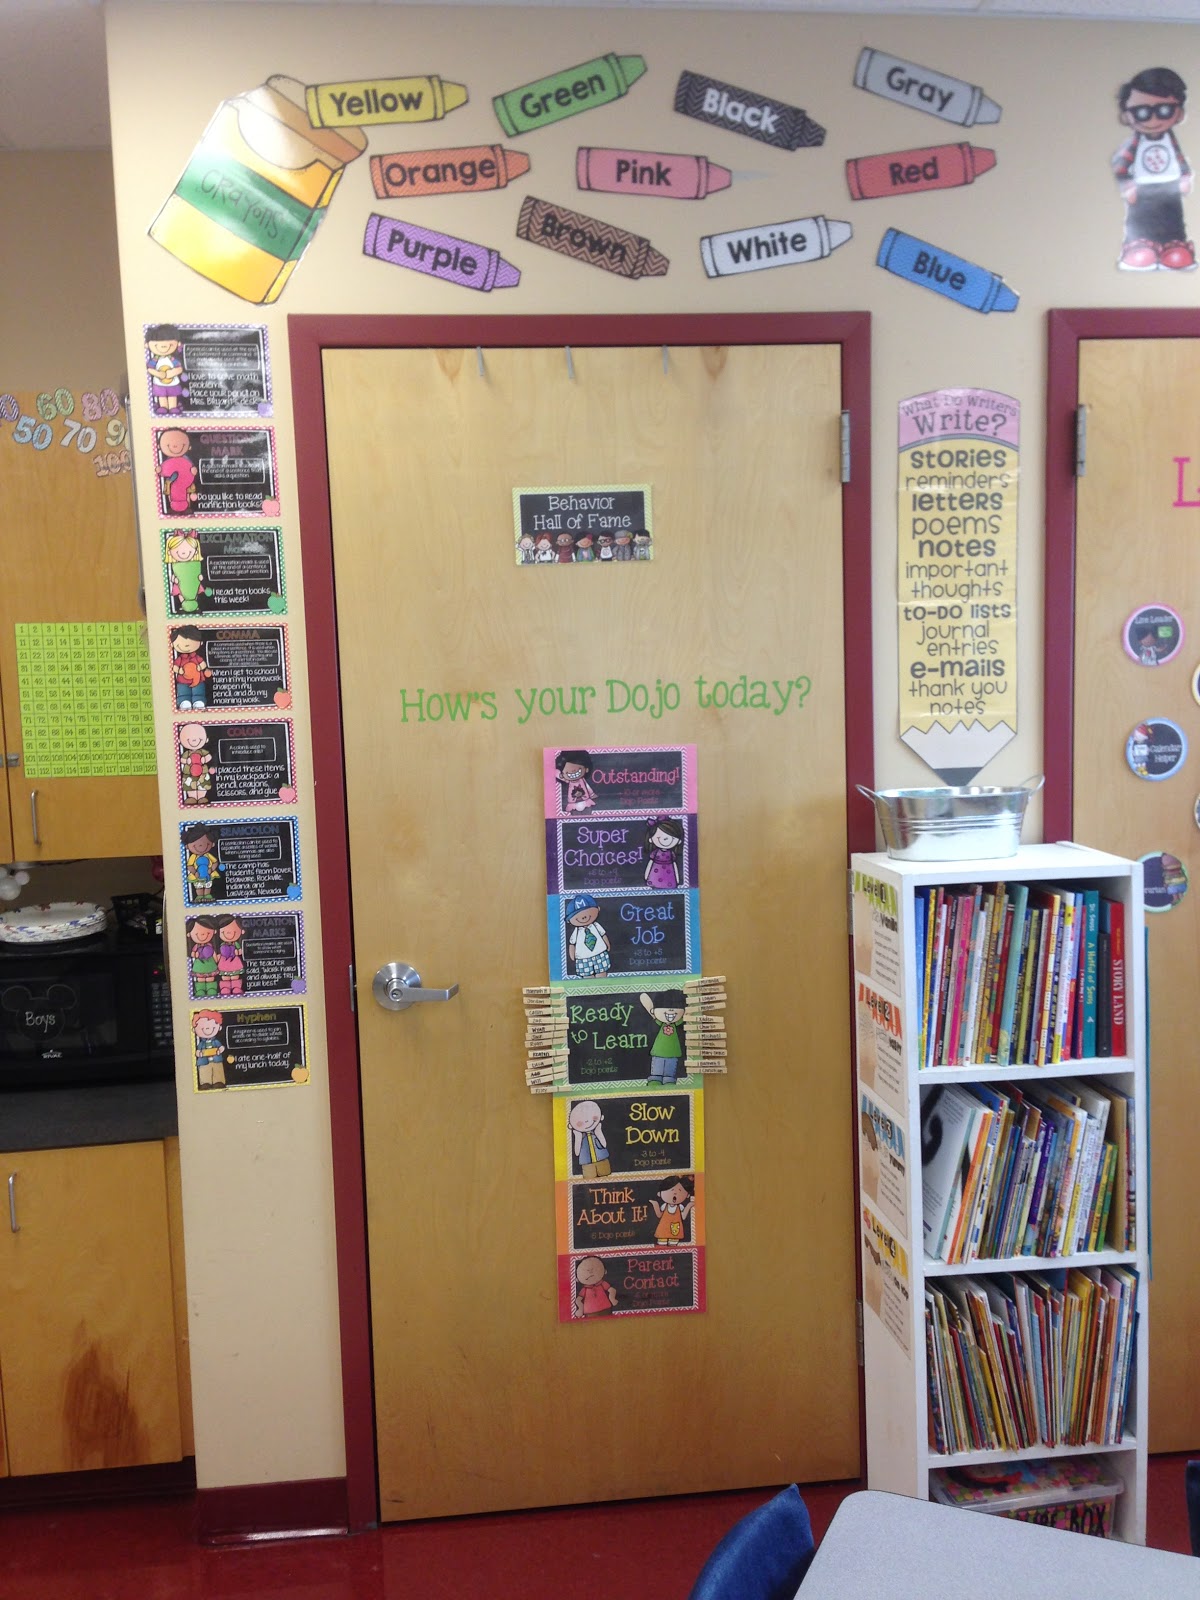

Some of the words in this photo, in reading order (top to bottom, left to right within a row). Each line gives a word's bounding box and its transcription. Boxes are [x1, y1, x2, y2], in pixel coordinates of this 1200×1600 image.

[518, 72, 607, 119] Green
[885, 66, 953, 113] Gray
[328, 88, 424, 118] Yellow
[702, 87, 780, 135] Black
[385, 154, 497, 187] Orange
[615, 159, 672, 186] Pink
[889, 156, 940, 186] Red
[539, 212, 630, 263] Brown
[727, 231, 808, 264] White
[386, 230, 479, 277] Purple
[912, 250, 967, 291] Blue
[36, 387, 75, 421] 60
[81, 388, 120, 421] 80
[902, 395, 940, 417] What
[967, 395, 1018, 417] Writers
[912, 409, 1007, 436] Write?
[12, 415, 53, 452] 50
[60, 418, 97, 453] 70
[905, 471, 1012, 490] reminders
[208, 493, 220, 502] you
[548, 495, 615, 511] Behavior
[533, 514, 562, 531] Hall
[566, 513, 584, 529] of
[587, 513, 632, 529] Fame
[912, 514, 1003, 540] poems
[918, 538, 997, 558] notes
[906, 559, 1008, 581] important
[911, 579, 1004, 603] thoughts
[971, 603, 1011, 619] lists
[60, 638, 67, 646] 14
[216, 631, 260, 640] COMMA
[916, 620, 990, 646] journal
[926, 638, 1000, 657] entries
[910, 658, 1005, 679] e-mails
[61, 677, 70, 685] 44
[908, 678, 966, 697] thank
[971, 680, 1008, 700] you
[102, 689, 111, 697] 57
[399, 688, 499, 723] How's
[514, 686, 597, 725] your
[605, 678, 681, 720] Dojo
[694, 674, 812, 716] today?
[929, 698, 987, 716] notes
[227, 727, 263, 736] COLON
[105, 740, 114, 748] 97
[218, 766, 241, 776] placed
[224, 774, 235, 783] my
[591, 767, 680, 786] Outstanding!
[221, 826, 279, 836] SEMICOLON
[576, 826, 630, 849] Super
[564, 846, 644, 867] Choices!
[575, 898, 586, 909] M
[620, 901, 675, 922] Great
[1088, 914, 1096, 932] Seuss
[630, 925, 665, 945] Job
[1087, 941, 1095, 949] A
[1087, 975, 1095, 984] of
[1113, 959, 1124, 992] STORY
[237, 1013, 277, 1024] Hyphen
[570, 1002, 634, 1026] Ready
[1113, 995, 1124, 1025] LAND
[25, 1011, 56, 1033] Boys
[570, 1029, 588, 1044] to
[592, 1031, 648, 1050] Learn
[580, 1067, 597, 1075] Dojo
[597, 1066, 618, 1075] points
[629, 1102, 676, 1122] Slow
[625, 1125, 680, 1145] Down
[634, 1159, 650, 1167] Dojo
[651, 1158, 672, 1167] points
[588, 1187, 635, 1206] Think
[576, 1209, 626, 1227] About
[631, 1205, 648, 1223] It!
[627, 1258, 675, 1273] Parent
[623, 1275, 680, 1290] Contact
